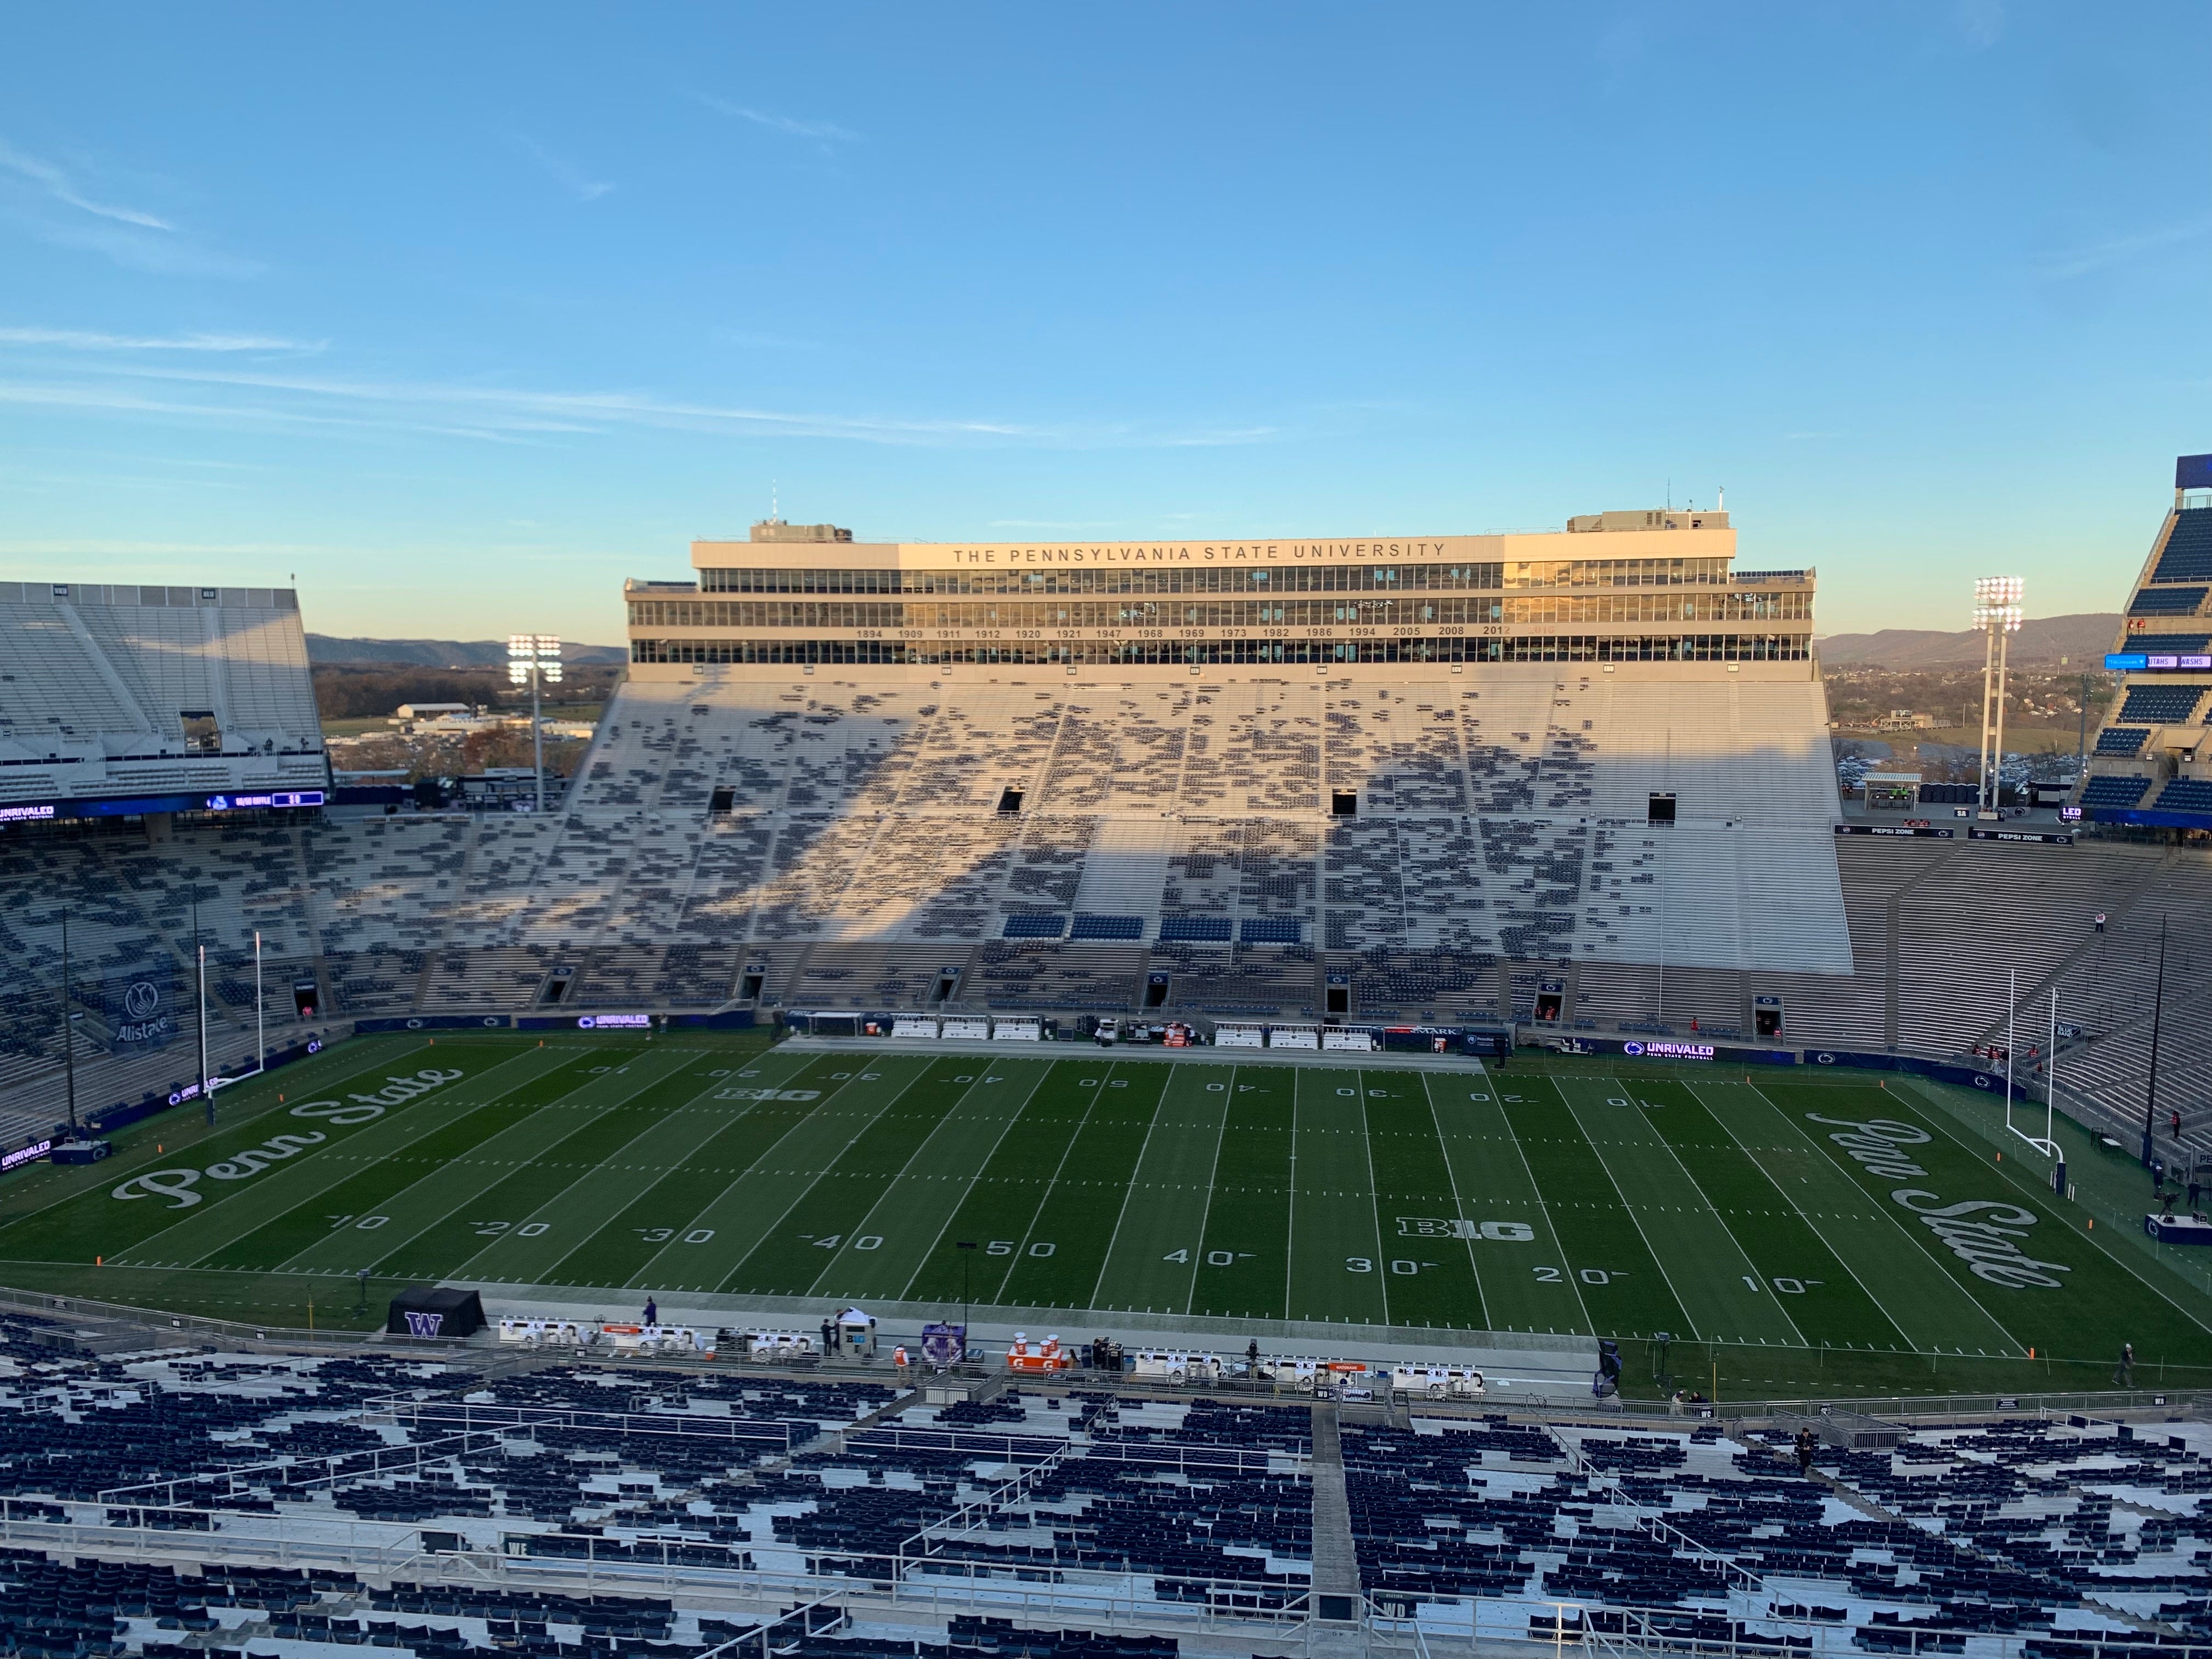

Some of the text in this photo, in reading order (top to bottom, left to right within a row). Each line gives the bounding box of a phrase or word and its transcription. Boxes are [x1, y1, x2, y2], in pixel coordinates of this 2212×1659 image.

[953, 544, 1444, 562] THE PENNSYLVANIA STATE UNIVERSITY
[1263, 628, 1289, 636] 1982
[1306, 628, 1332, 636] 1986
[1349, 628, 1375, 636] 1994
[1393, 628, 1420, 636] 2005
[1438, 627, 1464, 635] 2008
[1483, 626, 1510, 635] 2012
[1528, 625, 1555, 634] 2016
[0, 806, 54, 818] UNRIVALED
[2063, 807, 2081, 816] LED
[596, 1014, 648, 1025] UNRIVALED
[116, 1017, 168, 1041] Allstate
[1647, 1042, 1714, 1056] UNRIVALED
[181, 1077, 218, 1098] UNRILED
[111, 1067, 464, 1209] Penn State
[2, 1140, 50, 1166] UNRIVALED
[1804, 1112, 1933, 1181] Penn
[1890, 1188, 2072, 1289] State
[405, 1311, 444, 1339] W
[1013, 1358, 1024, 1369] G
[1043, 1360, 1053, 1371] G
[509, 1542, 527, 1555] WE
[1383, 1602, 1406, 1618] WD
